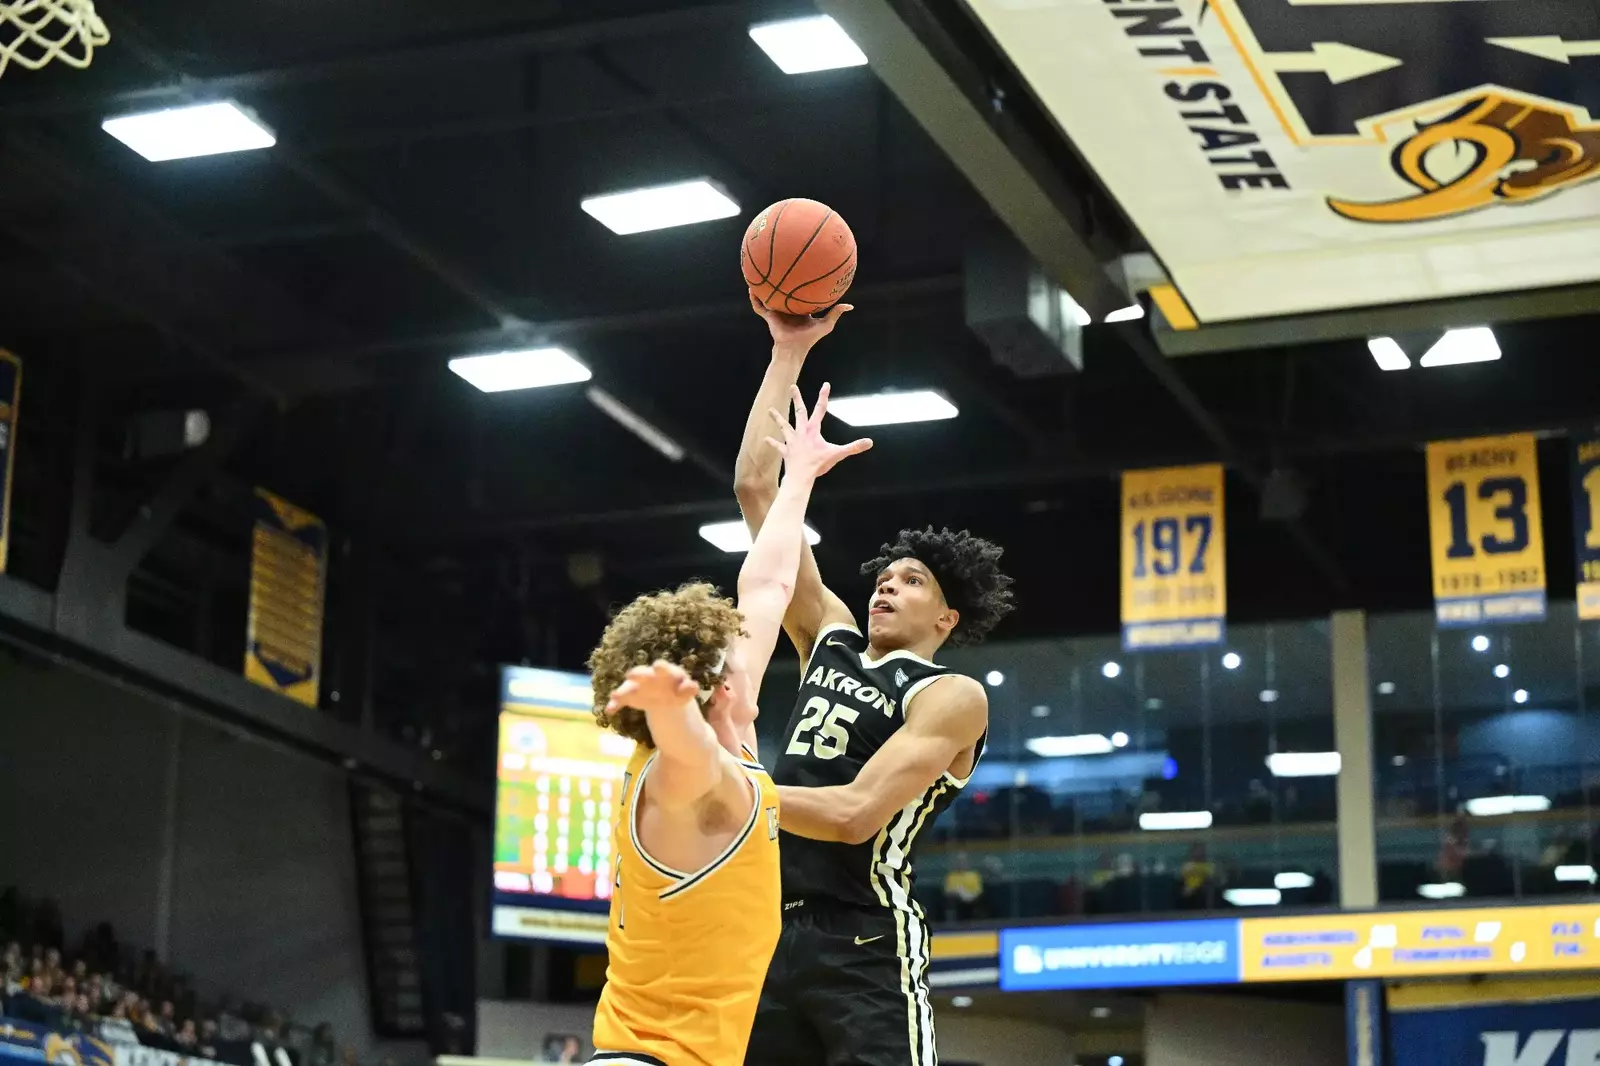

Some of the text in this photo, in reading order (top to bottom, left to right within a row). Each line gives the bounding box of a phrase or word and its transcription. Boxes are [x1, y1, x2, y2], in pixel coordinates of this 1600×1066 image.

[1103, 0, 1291, 190] NT STATE
[1132, 514, 1213, 578] 197
[1444, 476, 1530, 560] 13
[806, 665, 897, 719] AKRON
[785, 696, 860, 760] 25
[784, 899, 804, 911] ZIPS
